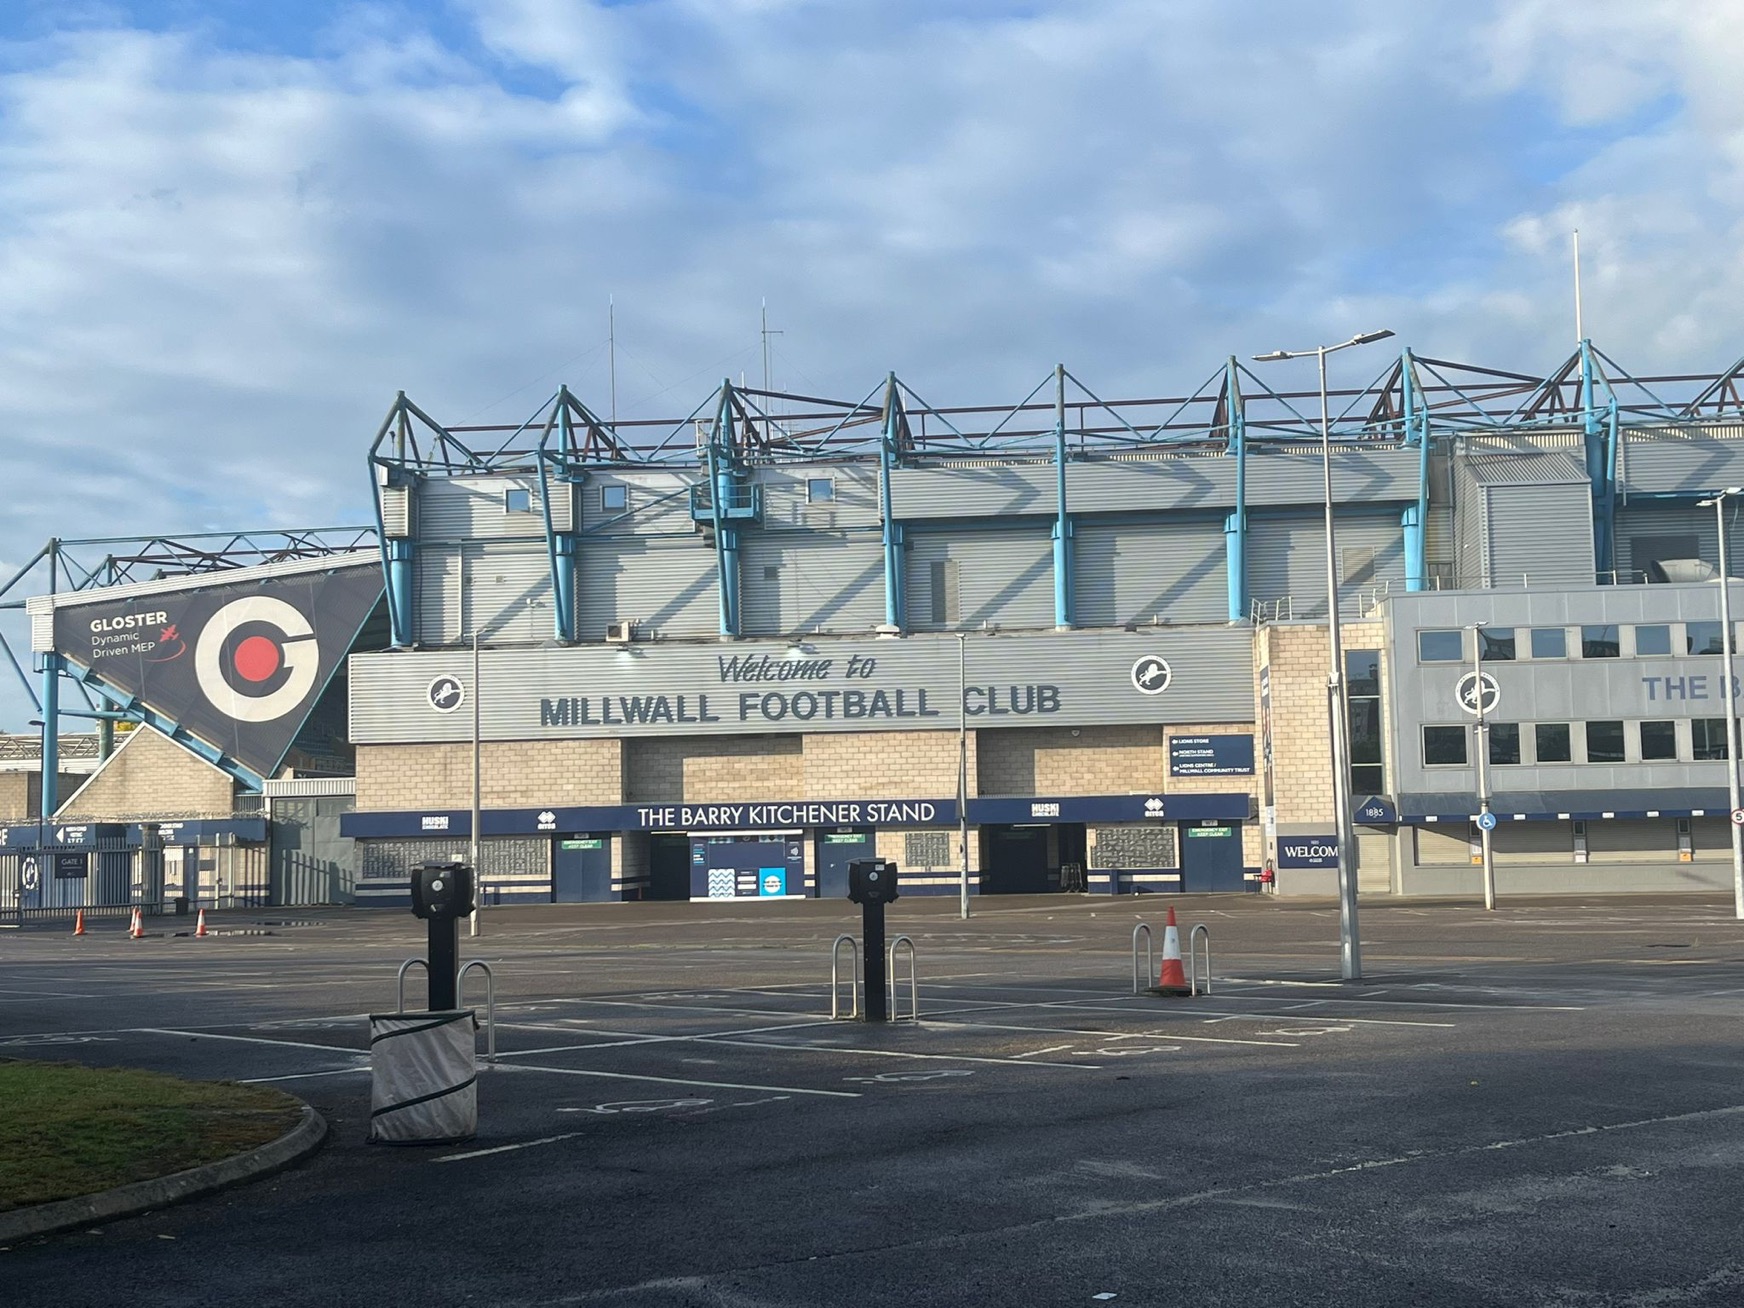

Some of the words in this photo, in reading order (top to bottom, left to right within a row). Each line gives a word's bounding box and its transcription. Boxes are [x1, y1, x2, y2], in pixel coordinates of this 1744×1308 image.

[90, 611, 168, 632] GLOSTER
[91, 632, 140, 646] Dynamic
[93, 646, 129, 658] Driven
[131, 641, 156, 653] MEP
[718, 653, 833, 683] Welcome
[845, 654, 877, 679] to
[1642, 676, 1708, 700] THE
[540, 694, 721, 727] MILLWALL
[739, 688, 940, 721] FOOTBALL
[963, 685, 1062, 716] CLUB
[638, 808, 675, 826] THE
[681, 806, 744, 826] BARRY
[750, 804, 861, 825] KITCHENER
[866, 802, 935, 822] STAND
[1031, 803, 1059, 812] HUSKI
[1365, 808, 1384, 817] 1885
[422, 816, 449, 825] HUSKI
[1736, 812, 1743, 821] 5
[1284, 845, 1339, 858] WELCOM
[61, 858, 78, 866] GATE
